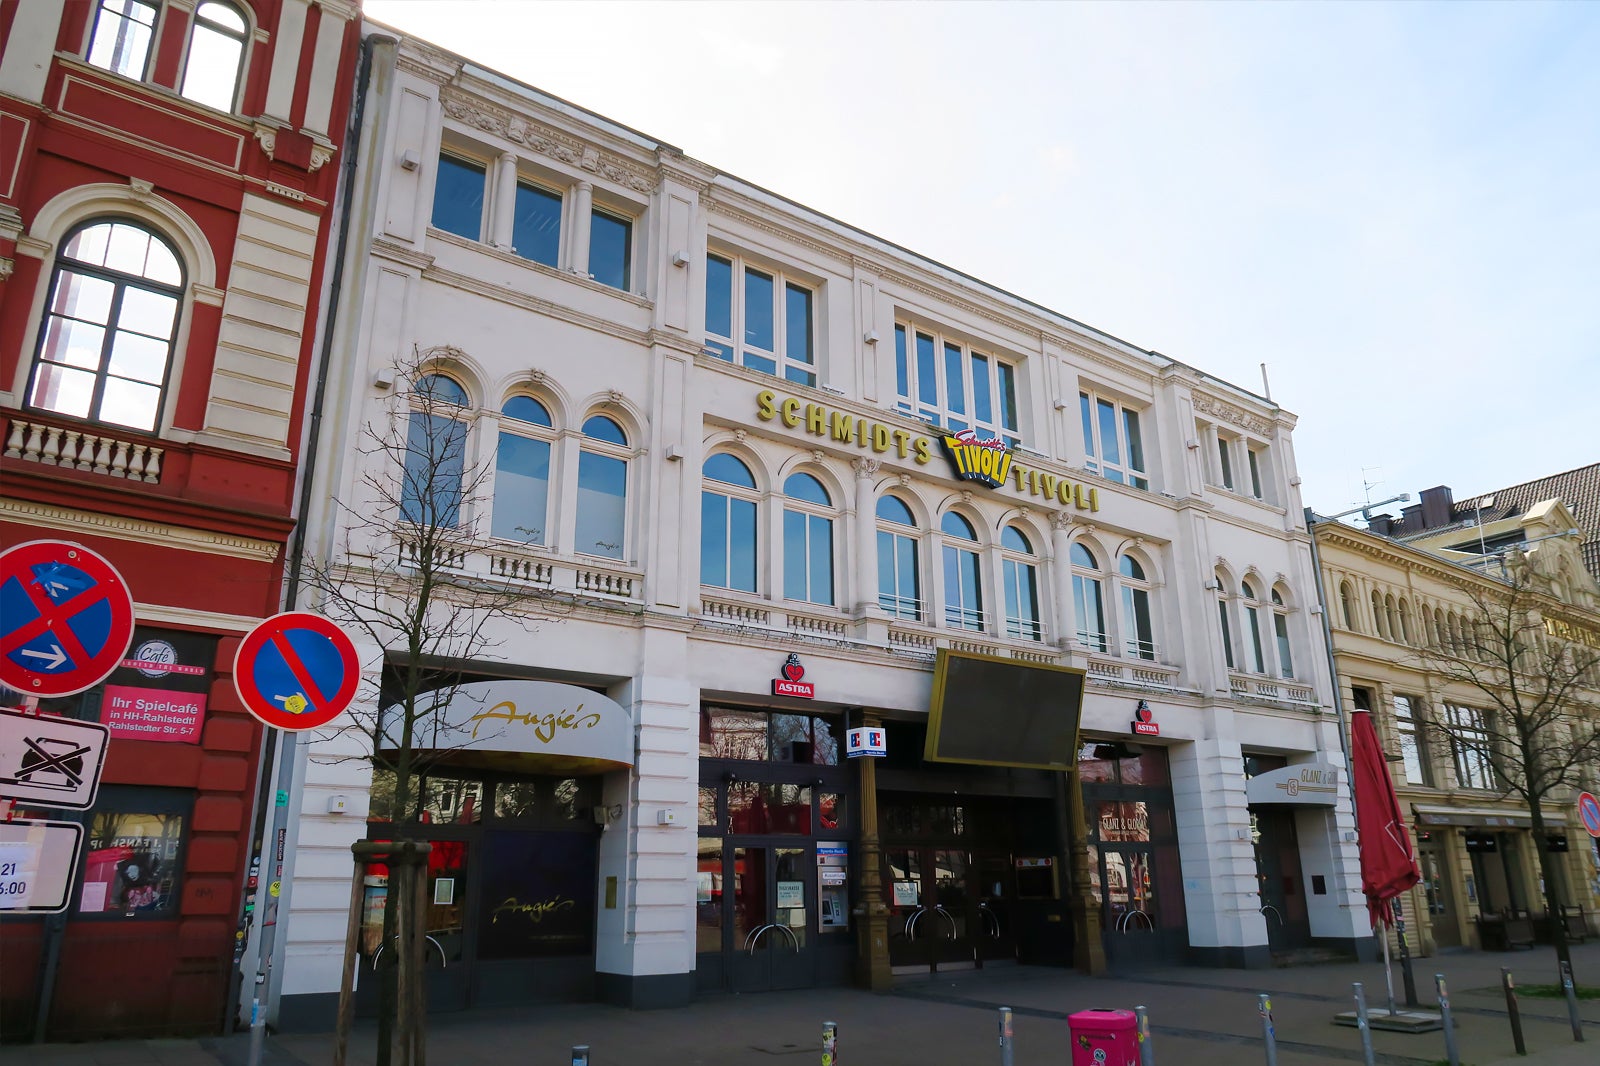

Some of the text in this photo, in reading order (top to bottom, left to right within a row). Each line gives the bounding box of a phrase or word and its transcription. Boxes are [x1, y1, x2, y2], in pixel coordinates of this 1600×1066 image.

[756, 390, 932, 465] SCHMIDTS
[944, 436, 1011, 485] TIVOLI
[1011, 465, 1100, 513] TIVOLI
[140, 646, 170, 667] Café
[778, 682, 812, 695] ASTRA
[112, 697, 199, 715] Ihr Spielcafé
[110, 711, 196, 725] in HH-Rahlstedt!
[108, 721, 194, 735] Rahlstedter Str. 5-7
[1137, 724, 1158, 733] ASTRA
[1301, 768, 1321, 783] GLANZ
[1102, 817, 1119, 830] GLANZ
[1121, 818, 1126, 830] &
